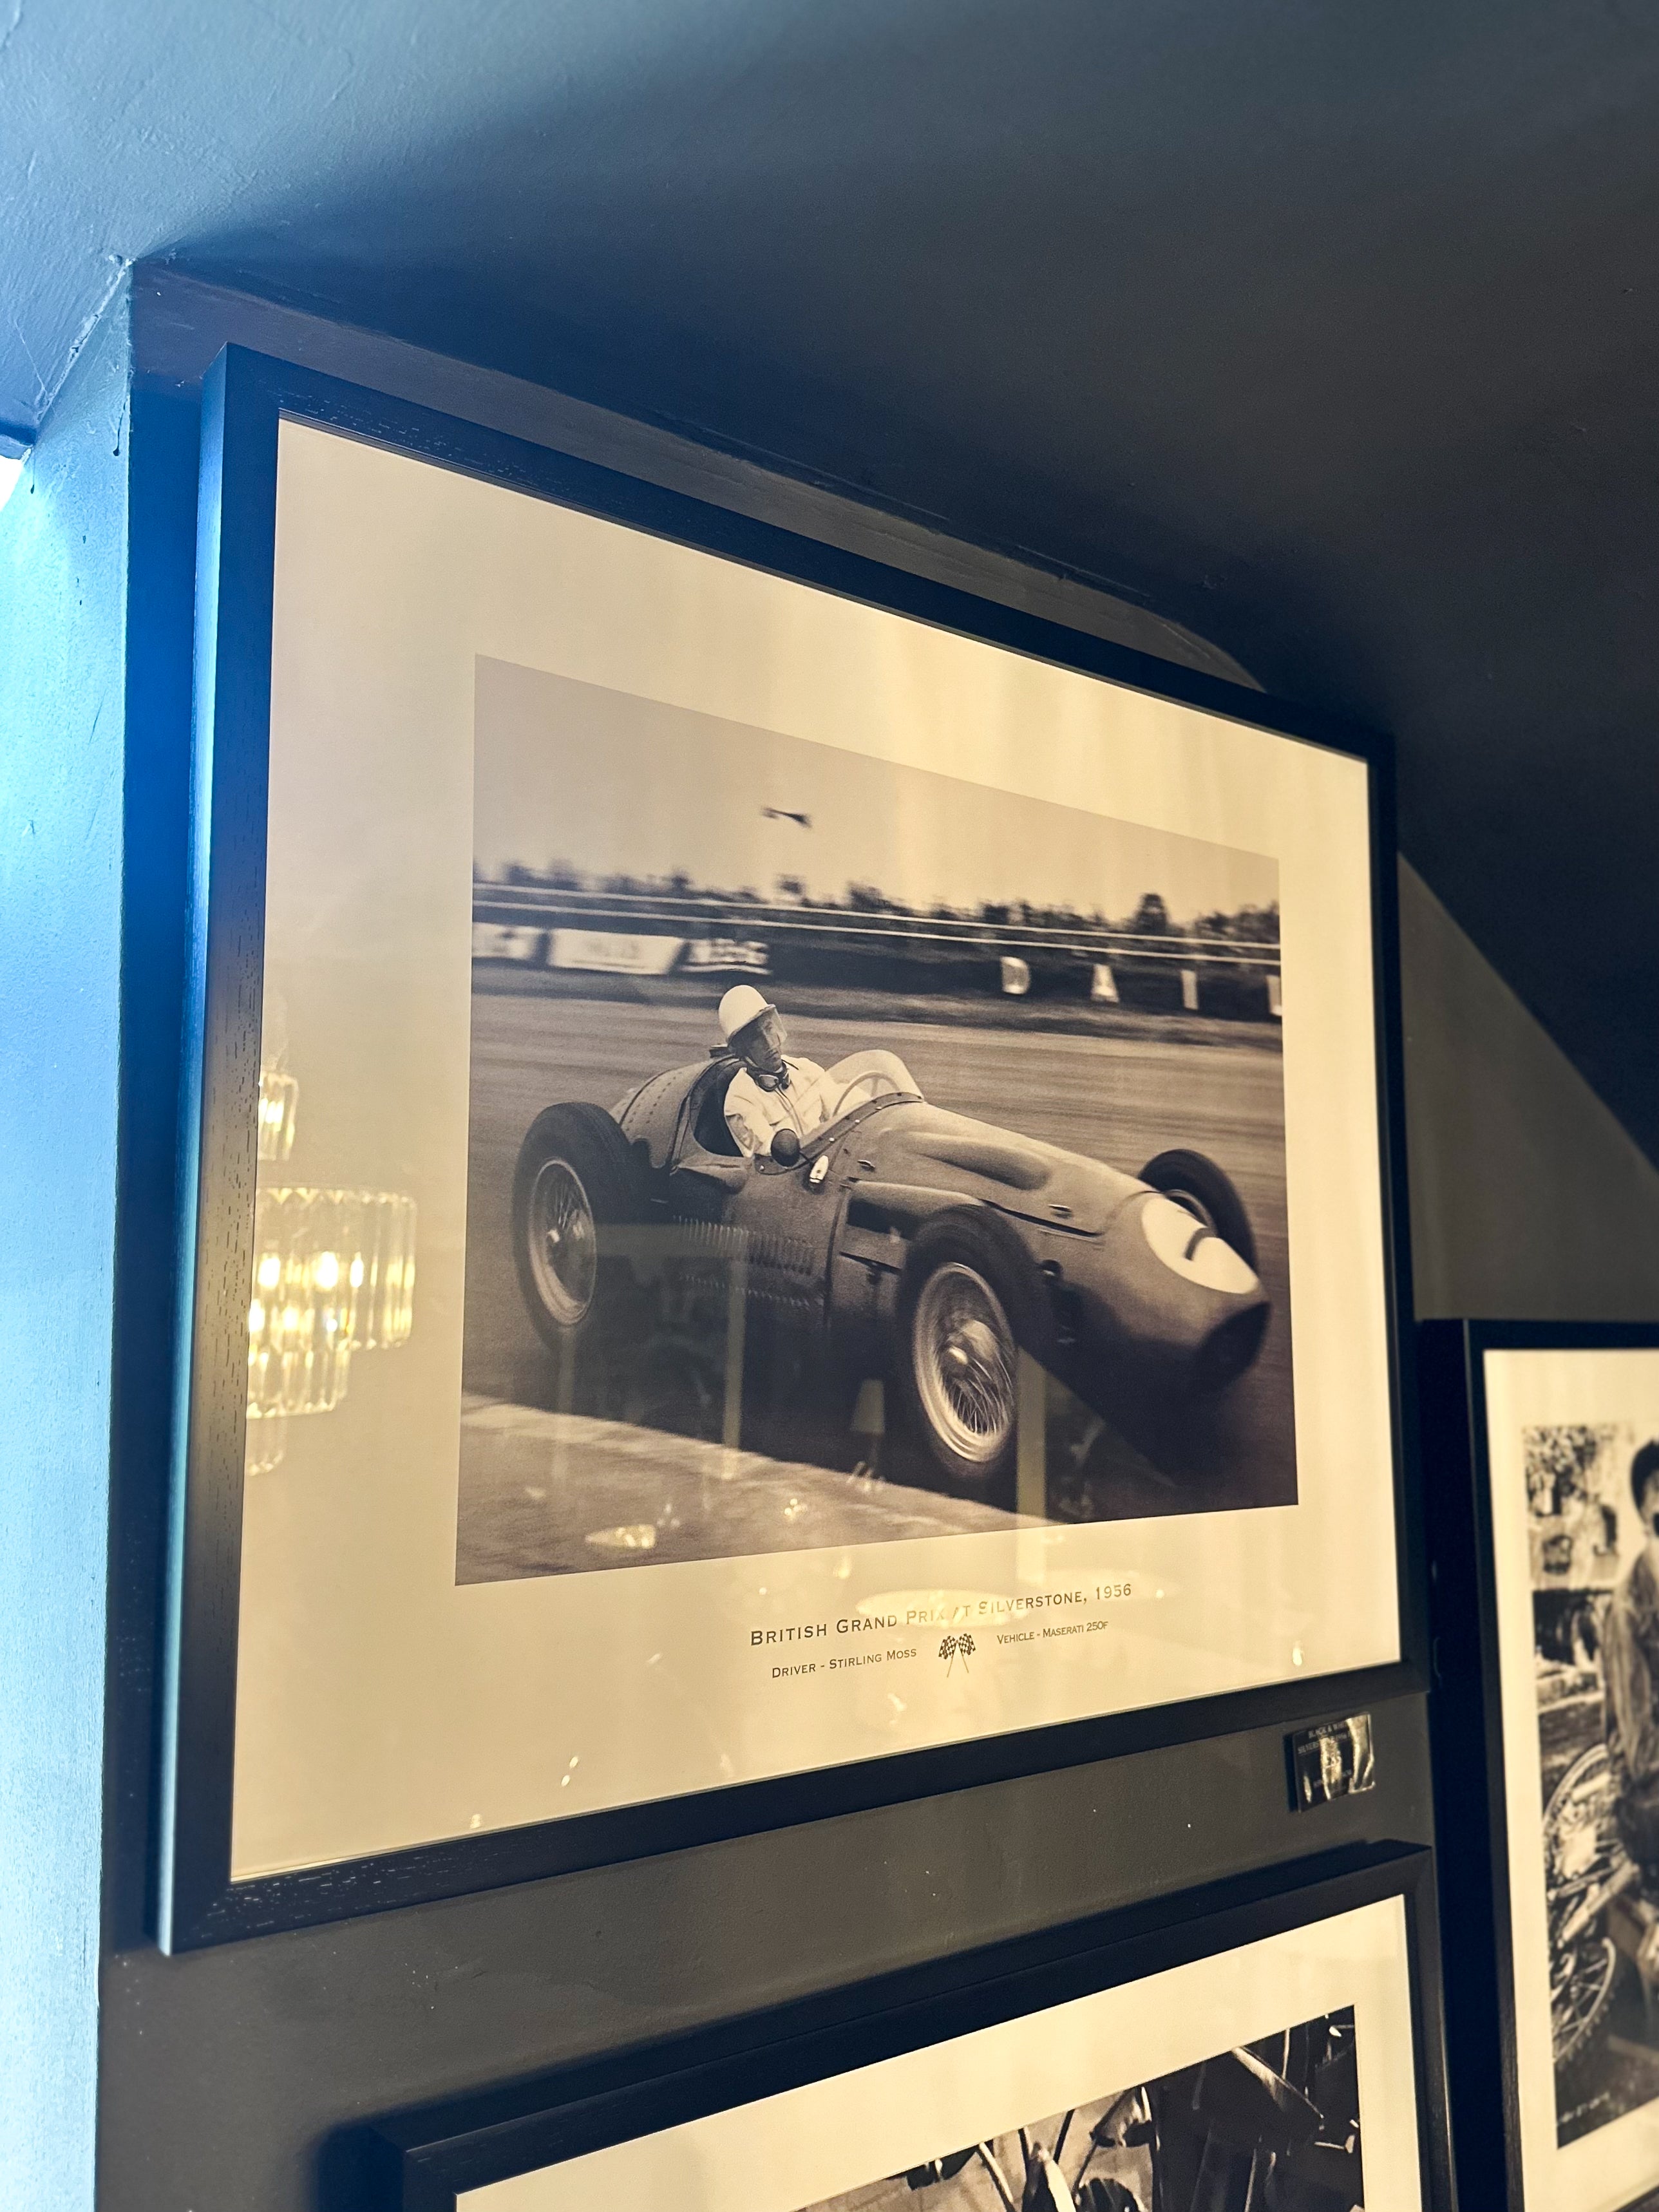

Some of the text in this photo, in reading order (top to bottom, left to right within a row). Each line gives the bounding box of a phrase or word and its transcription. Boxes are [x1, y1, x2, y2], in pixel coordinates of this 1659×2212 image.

[750, 1623, 827, 1646] BRITISH
[837, 1614, 897, 1634] GRAND
[906, 1609, 945, 1625] PRIX
[978, 1591, 1087, 1615] SILVERSTONE,
[1095, 1583, 1132, 1600] 1956
[996, 1631, 1035, 1645] VEHICLE
[1043, 1624, 1085, 1638] MASERATI
[1086, 1621, 1108, 1632] 250F
[772, 1663, 816, 1678] DRIVER
[829, 1654, 882, 1669] STIRLING
[886, 1649, 917, 1661] MOSS
